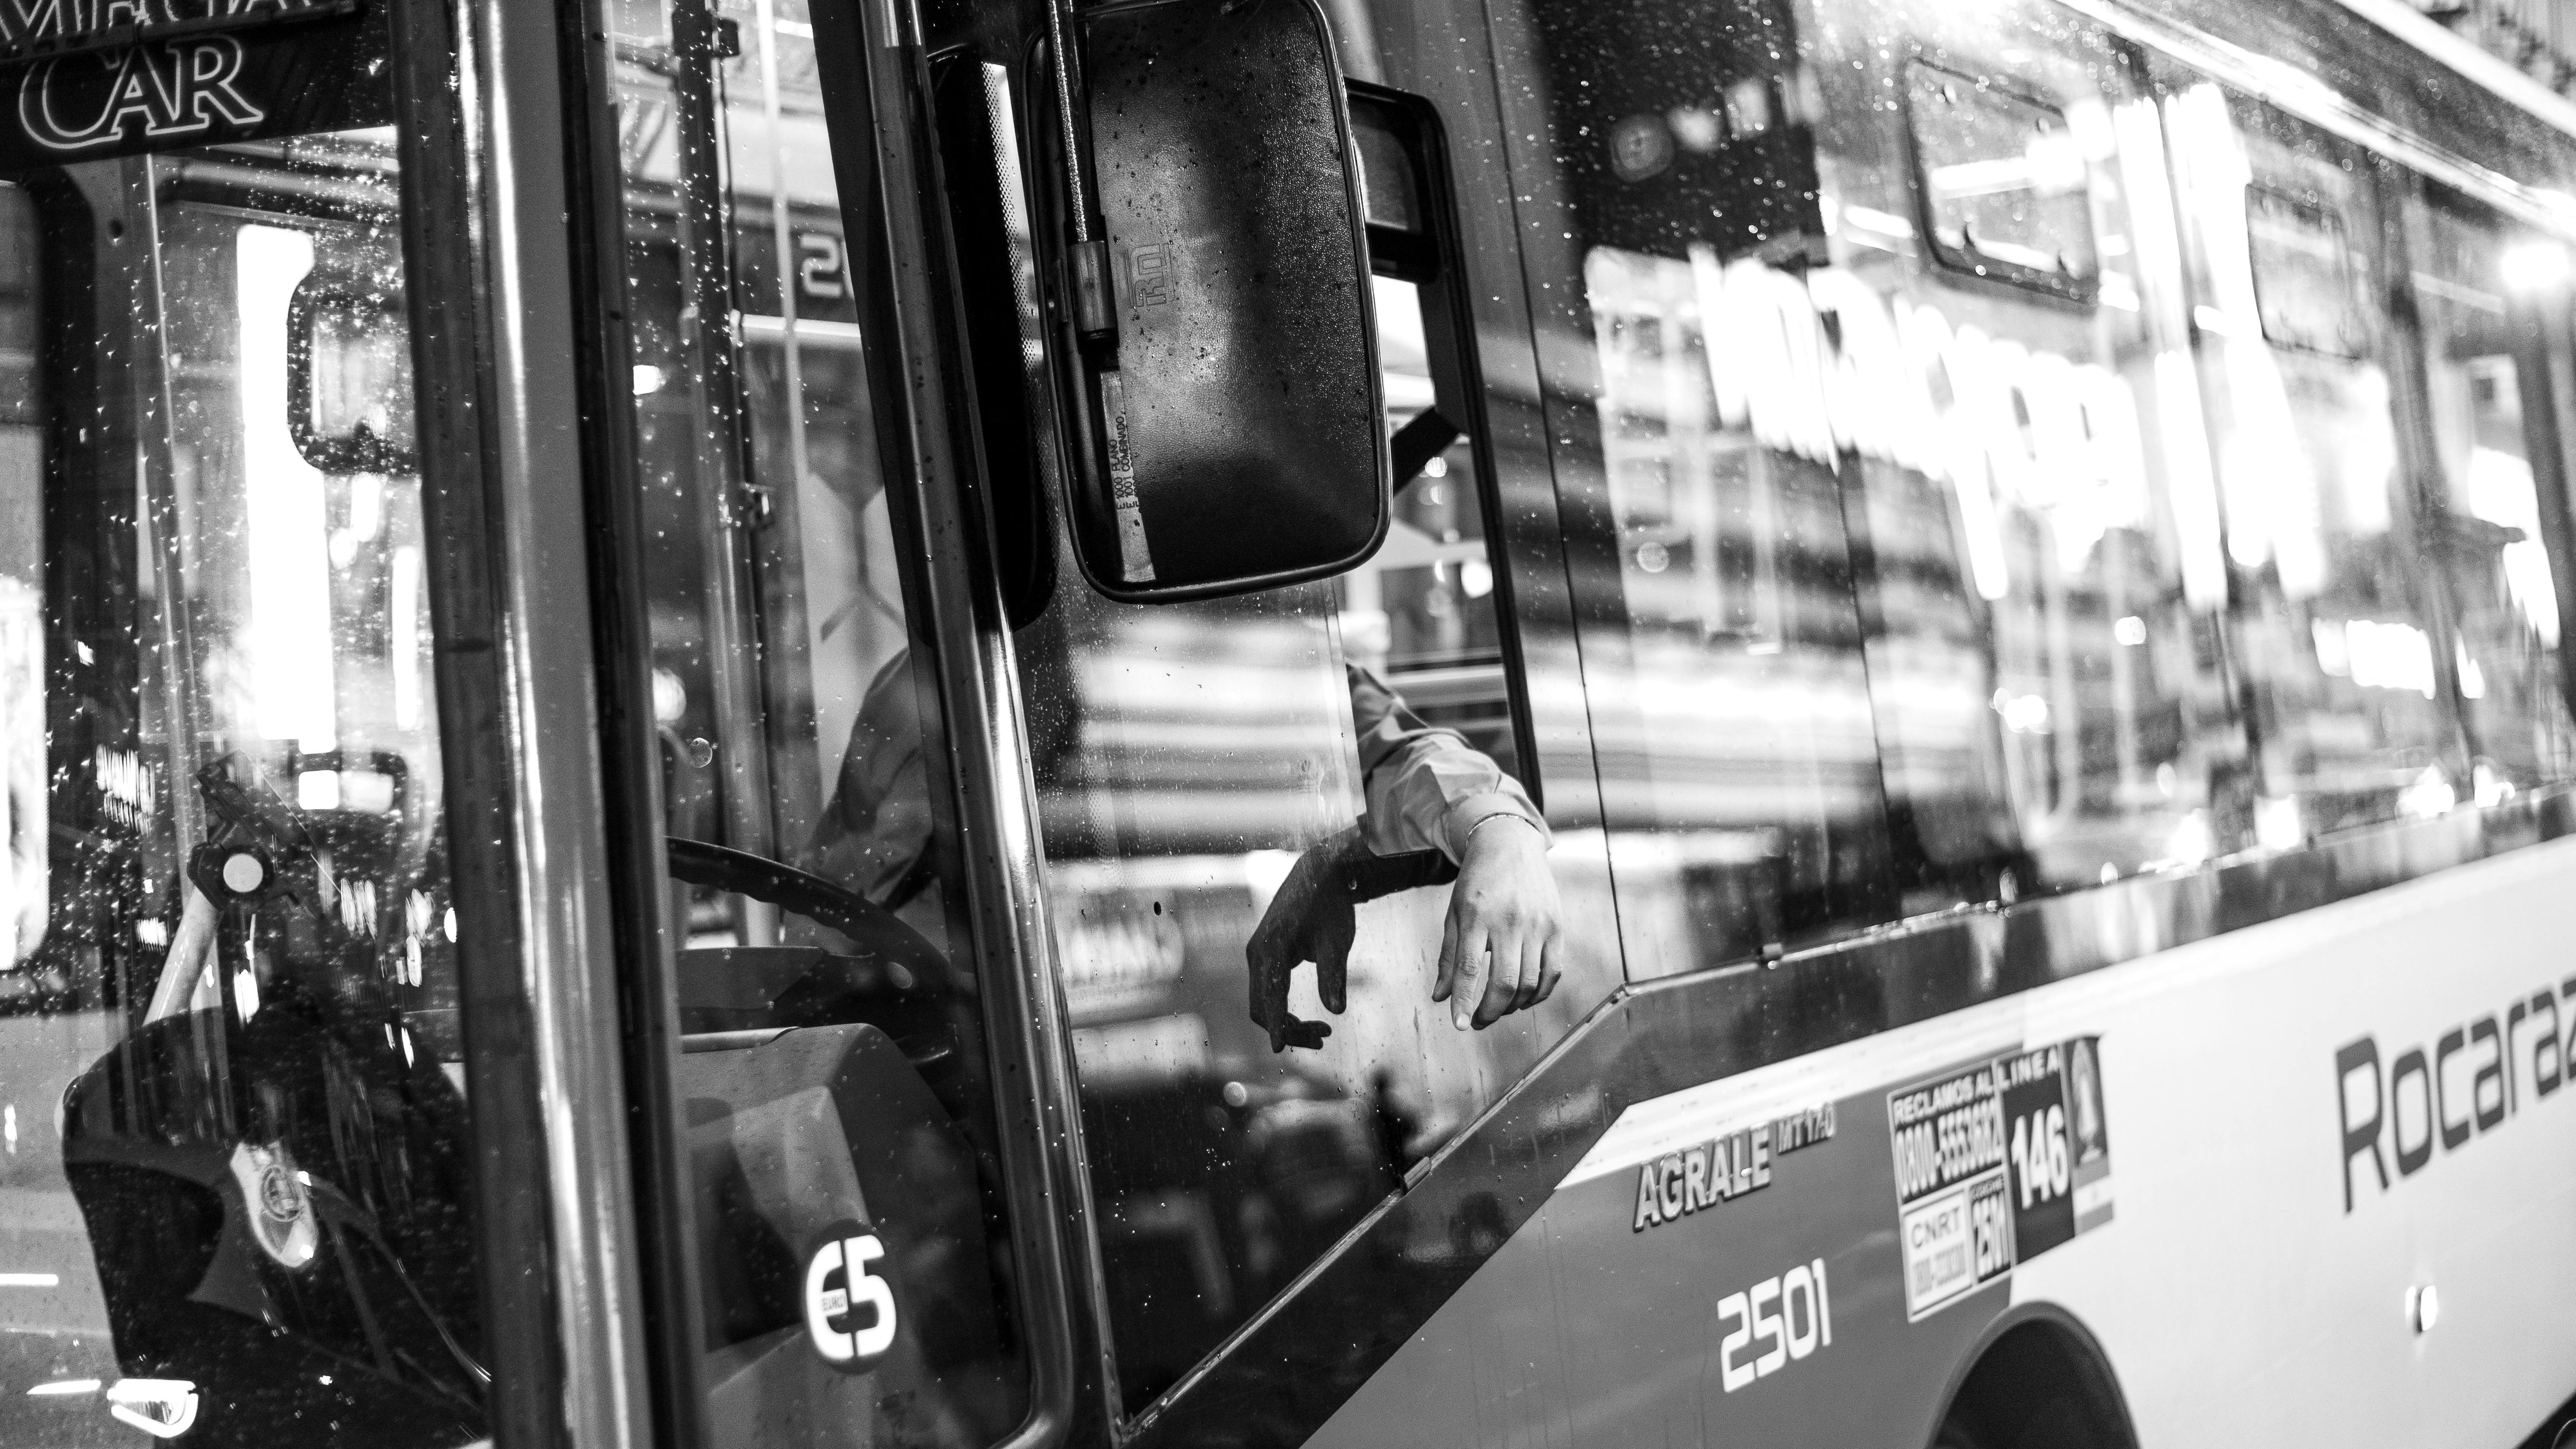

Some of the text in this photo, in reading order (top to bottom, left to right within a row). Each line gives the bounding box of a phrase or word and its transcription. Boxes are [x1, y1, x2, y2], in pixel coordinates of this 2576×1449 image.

[1115, 416, 1131, 472] COMBINADO
[1109, 439, 1126, 510] E 1000 PLANO
[1123, 477, 1134, 498] 1001
[1997, 1046, 2059, 1091] LINEA
[1893, 1071, 1994, 1125] RECLAMOS AL
[1634, 1126, 1770, 1232] AGRALE
[2011, 1103, 2070, 1209] 146
[1911, 1207, 1960, 1248] CNRT
[1717, 1257, 1831, 1392] 2501
